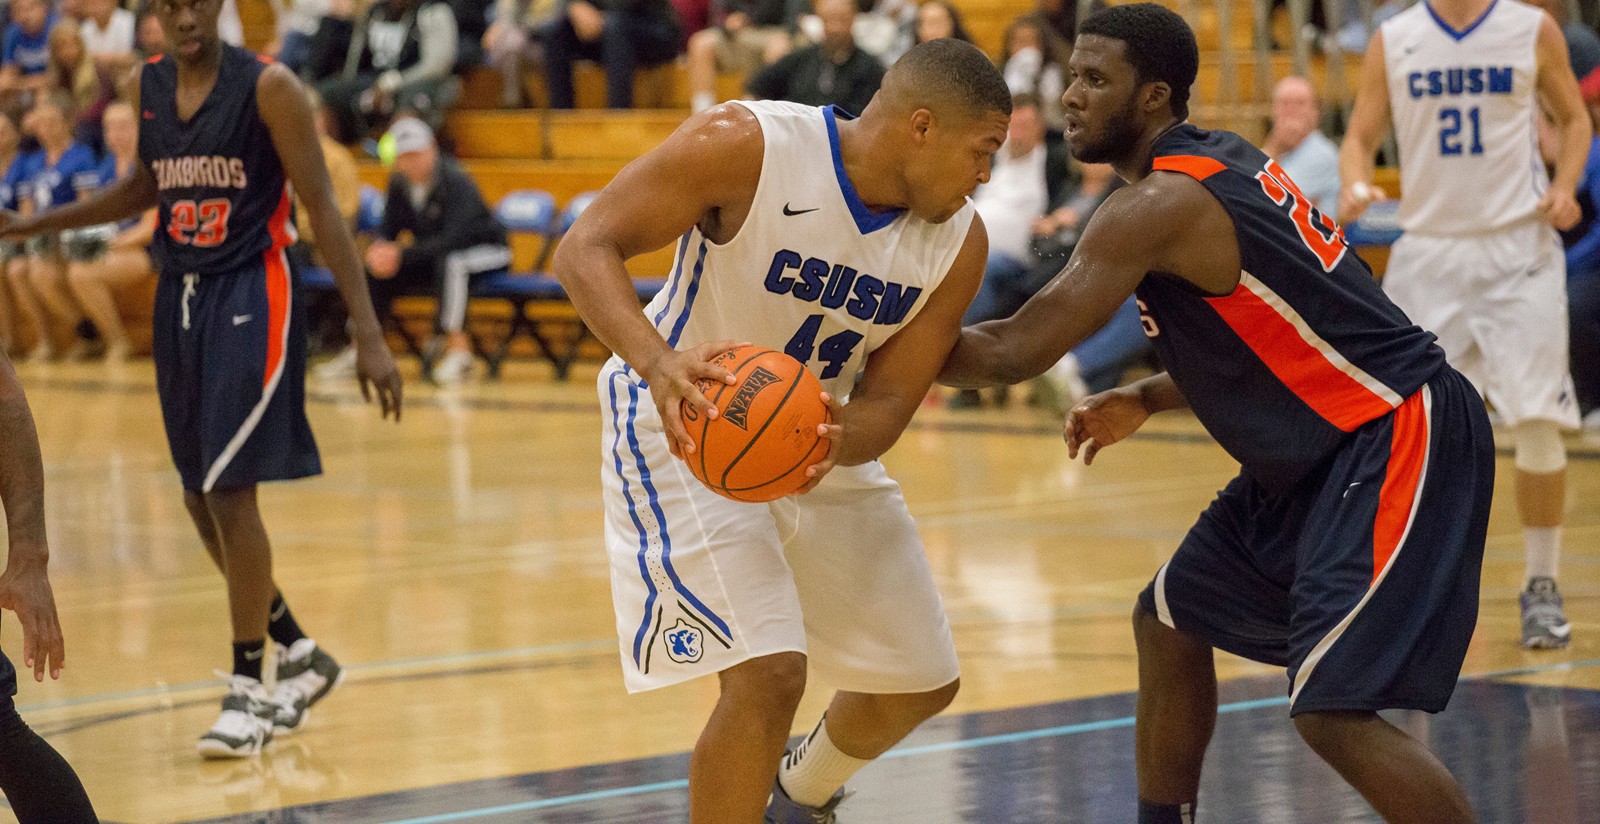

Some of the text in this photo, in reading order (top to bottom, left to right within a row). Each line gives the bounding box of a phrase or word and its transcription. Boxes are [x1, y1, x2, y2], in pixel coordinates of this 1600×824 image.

[1408, 66, 1513, 99] CSUSM
[1439, 106, 1484, 155] 21
[167, 198, 231, 248] 23
[1254, 158, 1349, 273] 2
[764, 248, 923, 325] CSUSM
[784, 314, 864, 380] 44
[723, 367, 780, 430] NAIA
